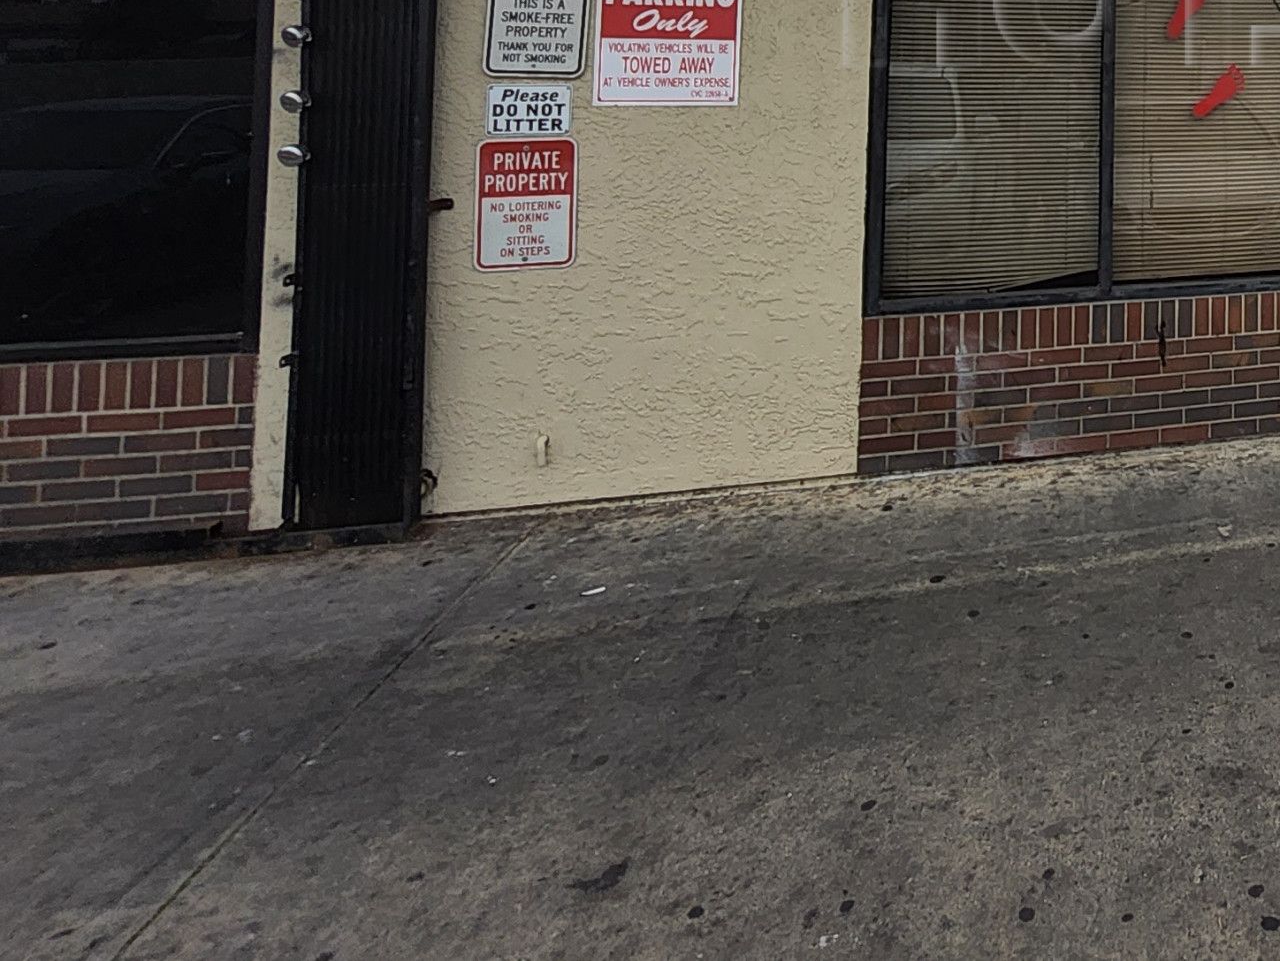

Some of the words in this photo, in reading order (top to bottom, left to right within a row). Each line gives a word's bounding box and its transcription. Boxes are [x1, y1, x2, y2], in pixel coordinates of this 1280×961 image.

[543, 0, 553, 9] IS
[557, 0, 566, 10] A
[501, 11, 575, 25] SMOKE-FREE
[632, 8, 709, 39] Only
[505, 25, 568, 38] PROPERTY
[498, 41, 529, 52] THANK
[532, 42, 552, 52] YOU
[555, 43, 574, 53] FOR
[608, 42, 651, 54] VIOLATING
[654, 43, 693, 54] VEHICLES
[696, 43, 715, 54] WILL
[718, 44, 729, 54] BE
[502, 53, 522, 63] NOT
[524, 54, 567, 64] SMOKING
[622, 56, 671, 74] TOWED
[679, 57, 715, 75] AWAY
[602, 77, 613, 88] AT
[616, 77, 650, 88] VEHICLE
[654, 77, 690, 88] OWNER'S
[693, 77, 731, 89] EXPENSE
[500, 88, 560, 103] Please
[492, 103, 518, 117] DO
[526, 103, 566, 117] NOT
[492, 118, 563, 132] LITTER
[493, 150, 561, 171] PRIVATE
[484, 172, 569, 193] PROPERTY
[490, 203, 505, 213] NO
[509, 201, 562, 212] LOITERING
[502, 213, 549, 223] SMOKING
[518, 224, 533, 234] OR
[506, 235, 545, 246] SITTING
[500, 247, 515, 257] ON
[518, 246, 551, 256] STEPS
